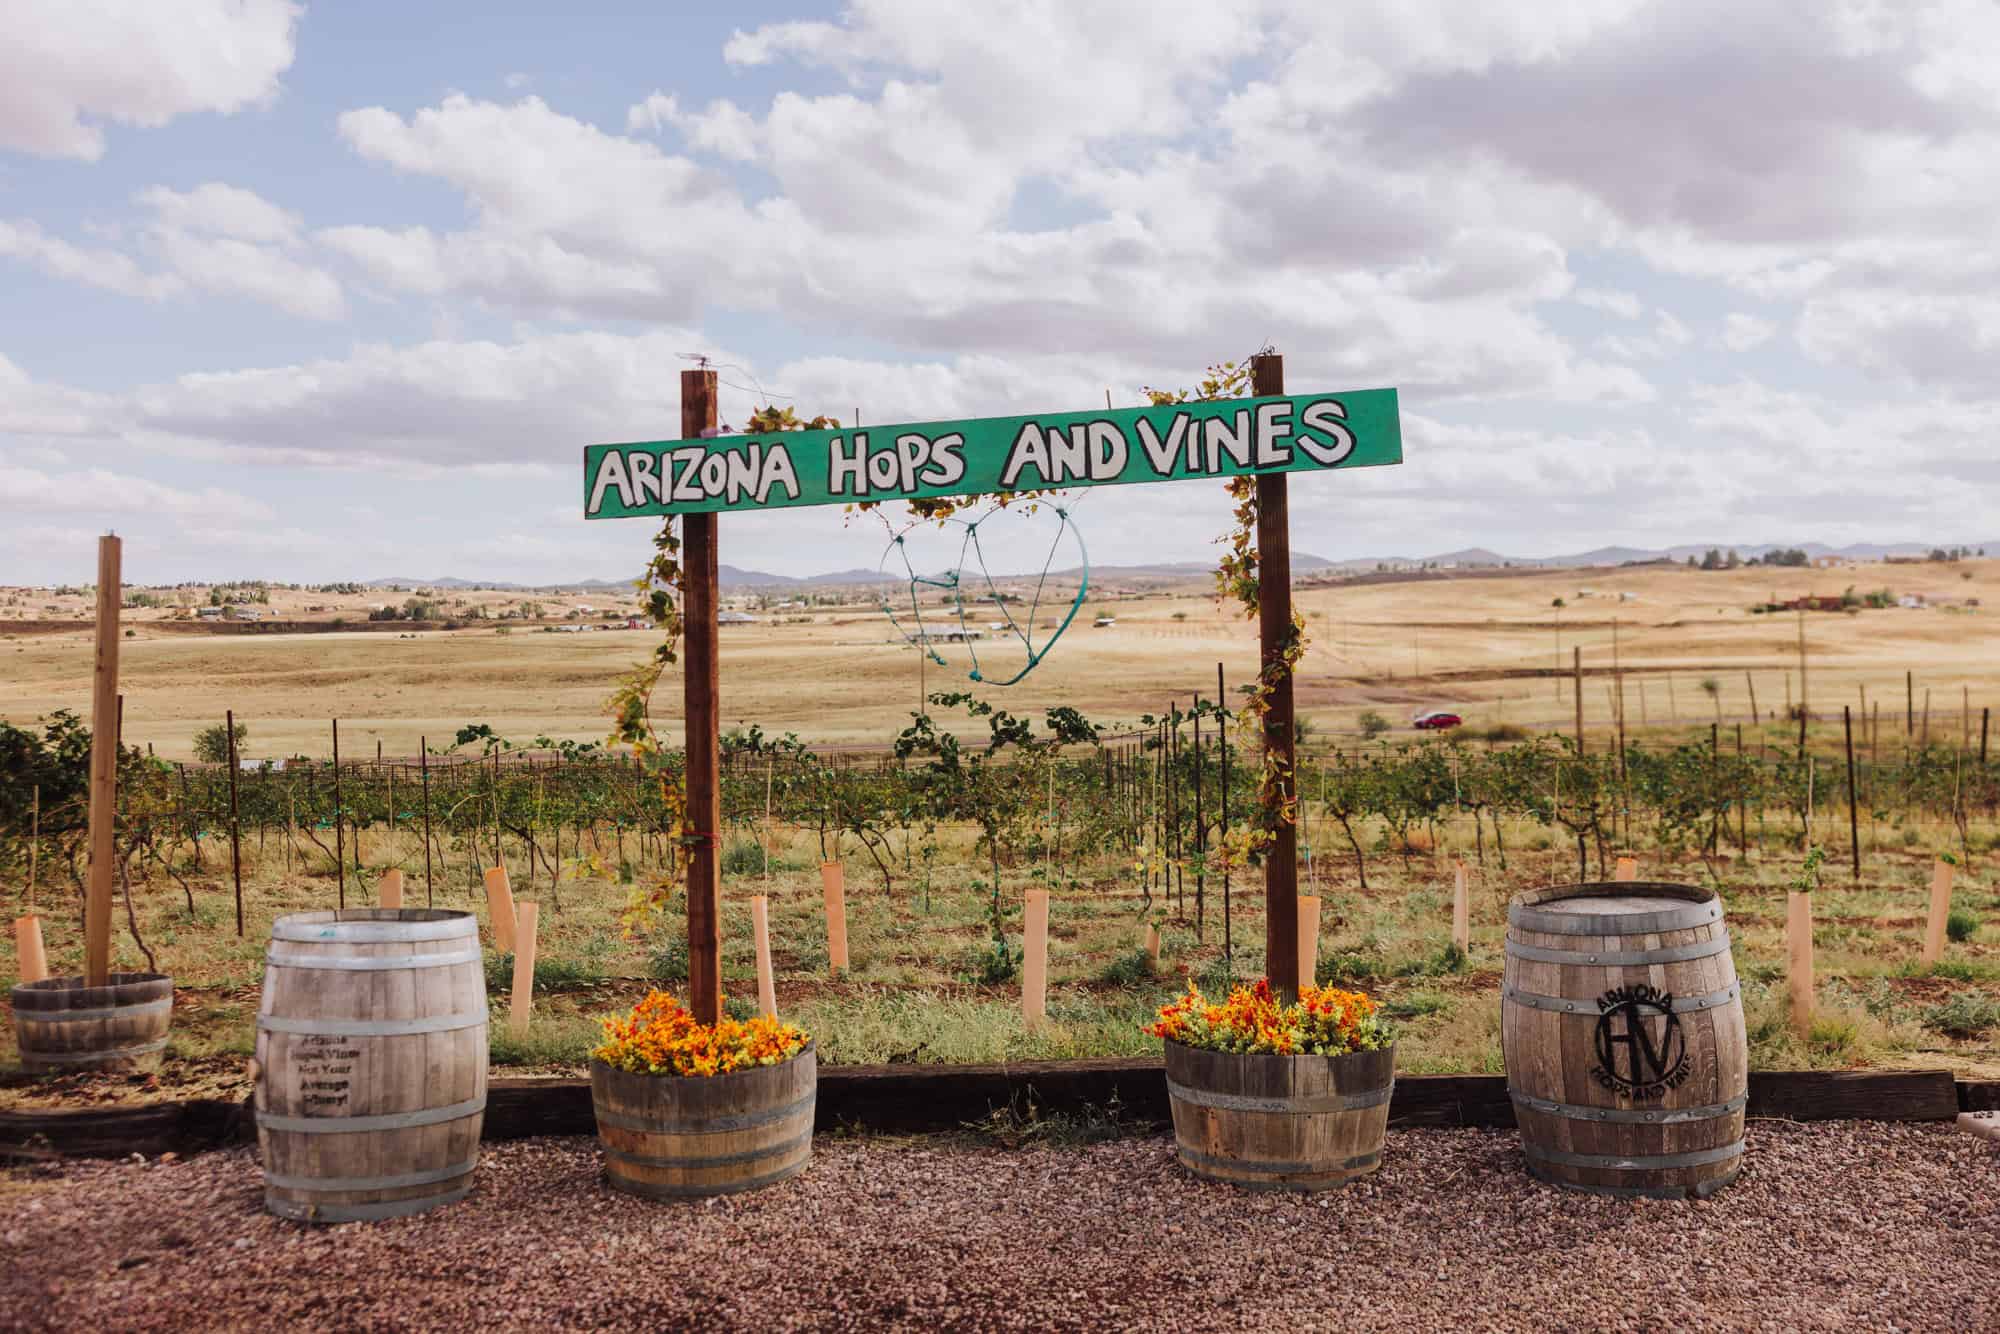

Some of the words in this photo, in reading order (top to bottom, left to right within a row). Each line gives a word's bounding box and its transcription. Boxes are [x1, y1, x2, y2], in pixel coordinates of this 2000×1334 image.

[588, 441, 800, 515] ARIZONA
[827, 431, 967, 496] HOPS
[998, 420, 1128, 489] AND
[1135, 399, 1358, 477] VINES
[1592, 1065, 1633, 1098] HOPS
[1633, 1084, 1666, 1103] AND
